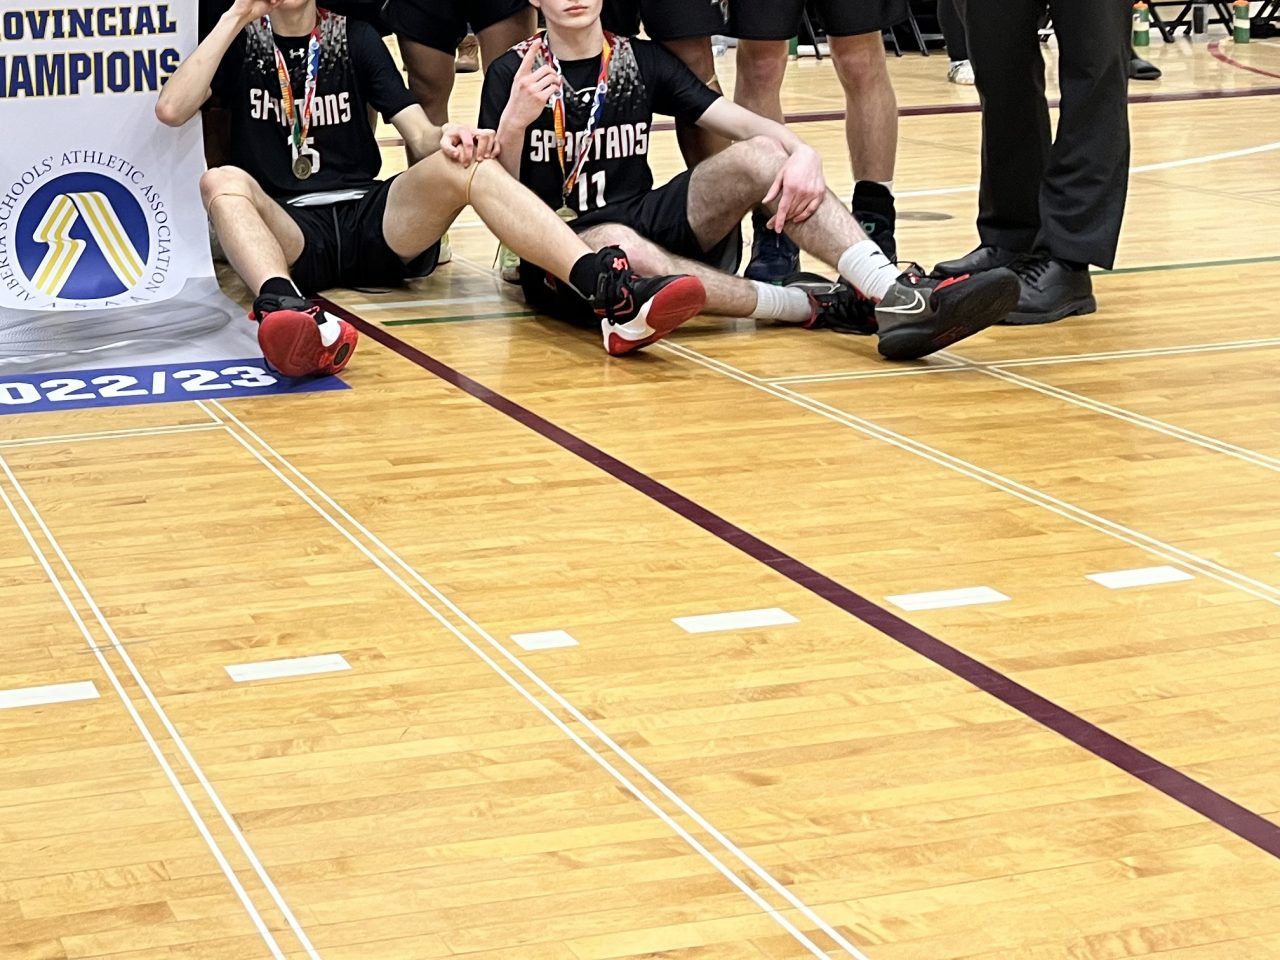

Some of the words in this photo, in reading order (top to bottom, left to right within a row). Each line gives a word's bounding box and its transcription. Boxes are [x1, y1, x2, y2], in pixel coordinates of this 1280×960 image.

[60, 150, 144, 184] ATHLETIC
[141, 184, 170, 292] ASSOCIATION
[575, 171, 607, 211] 11
